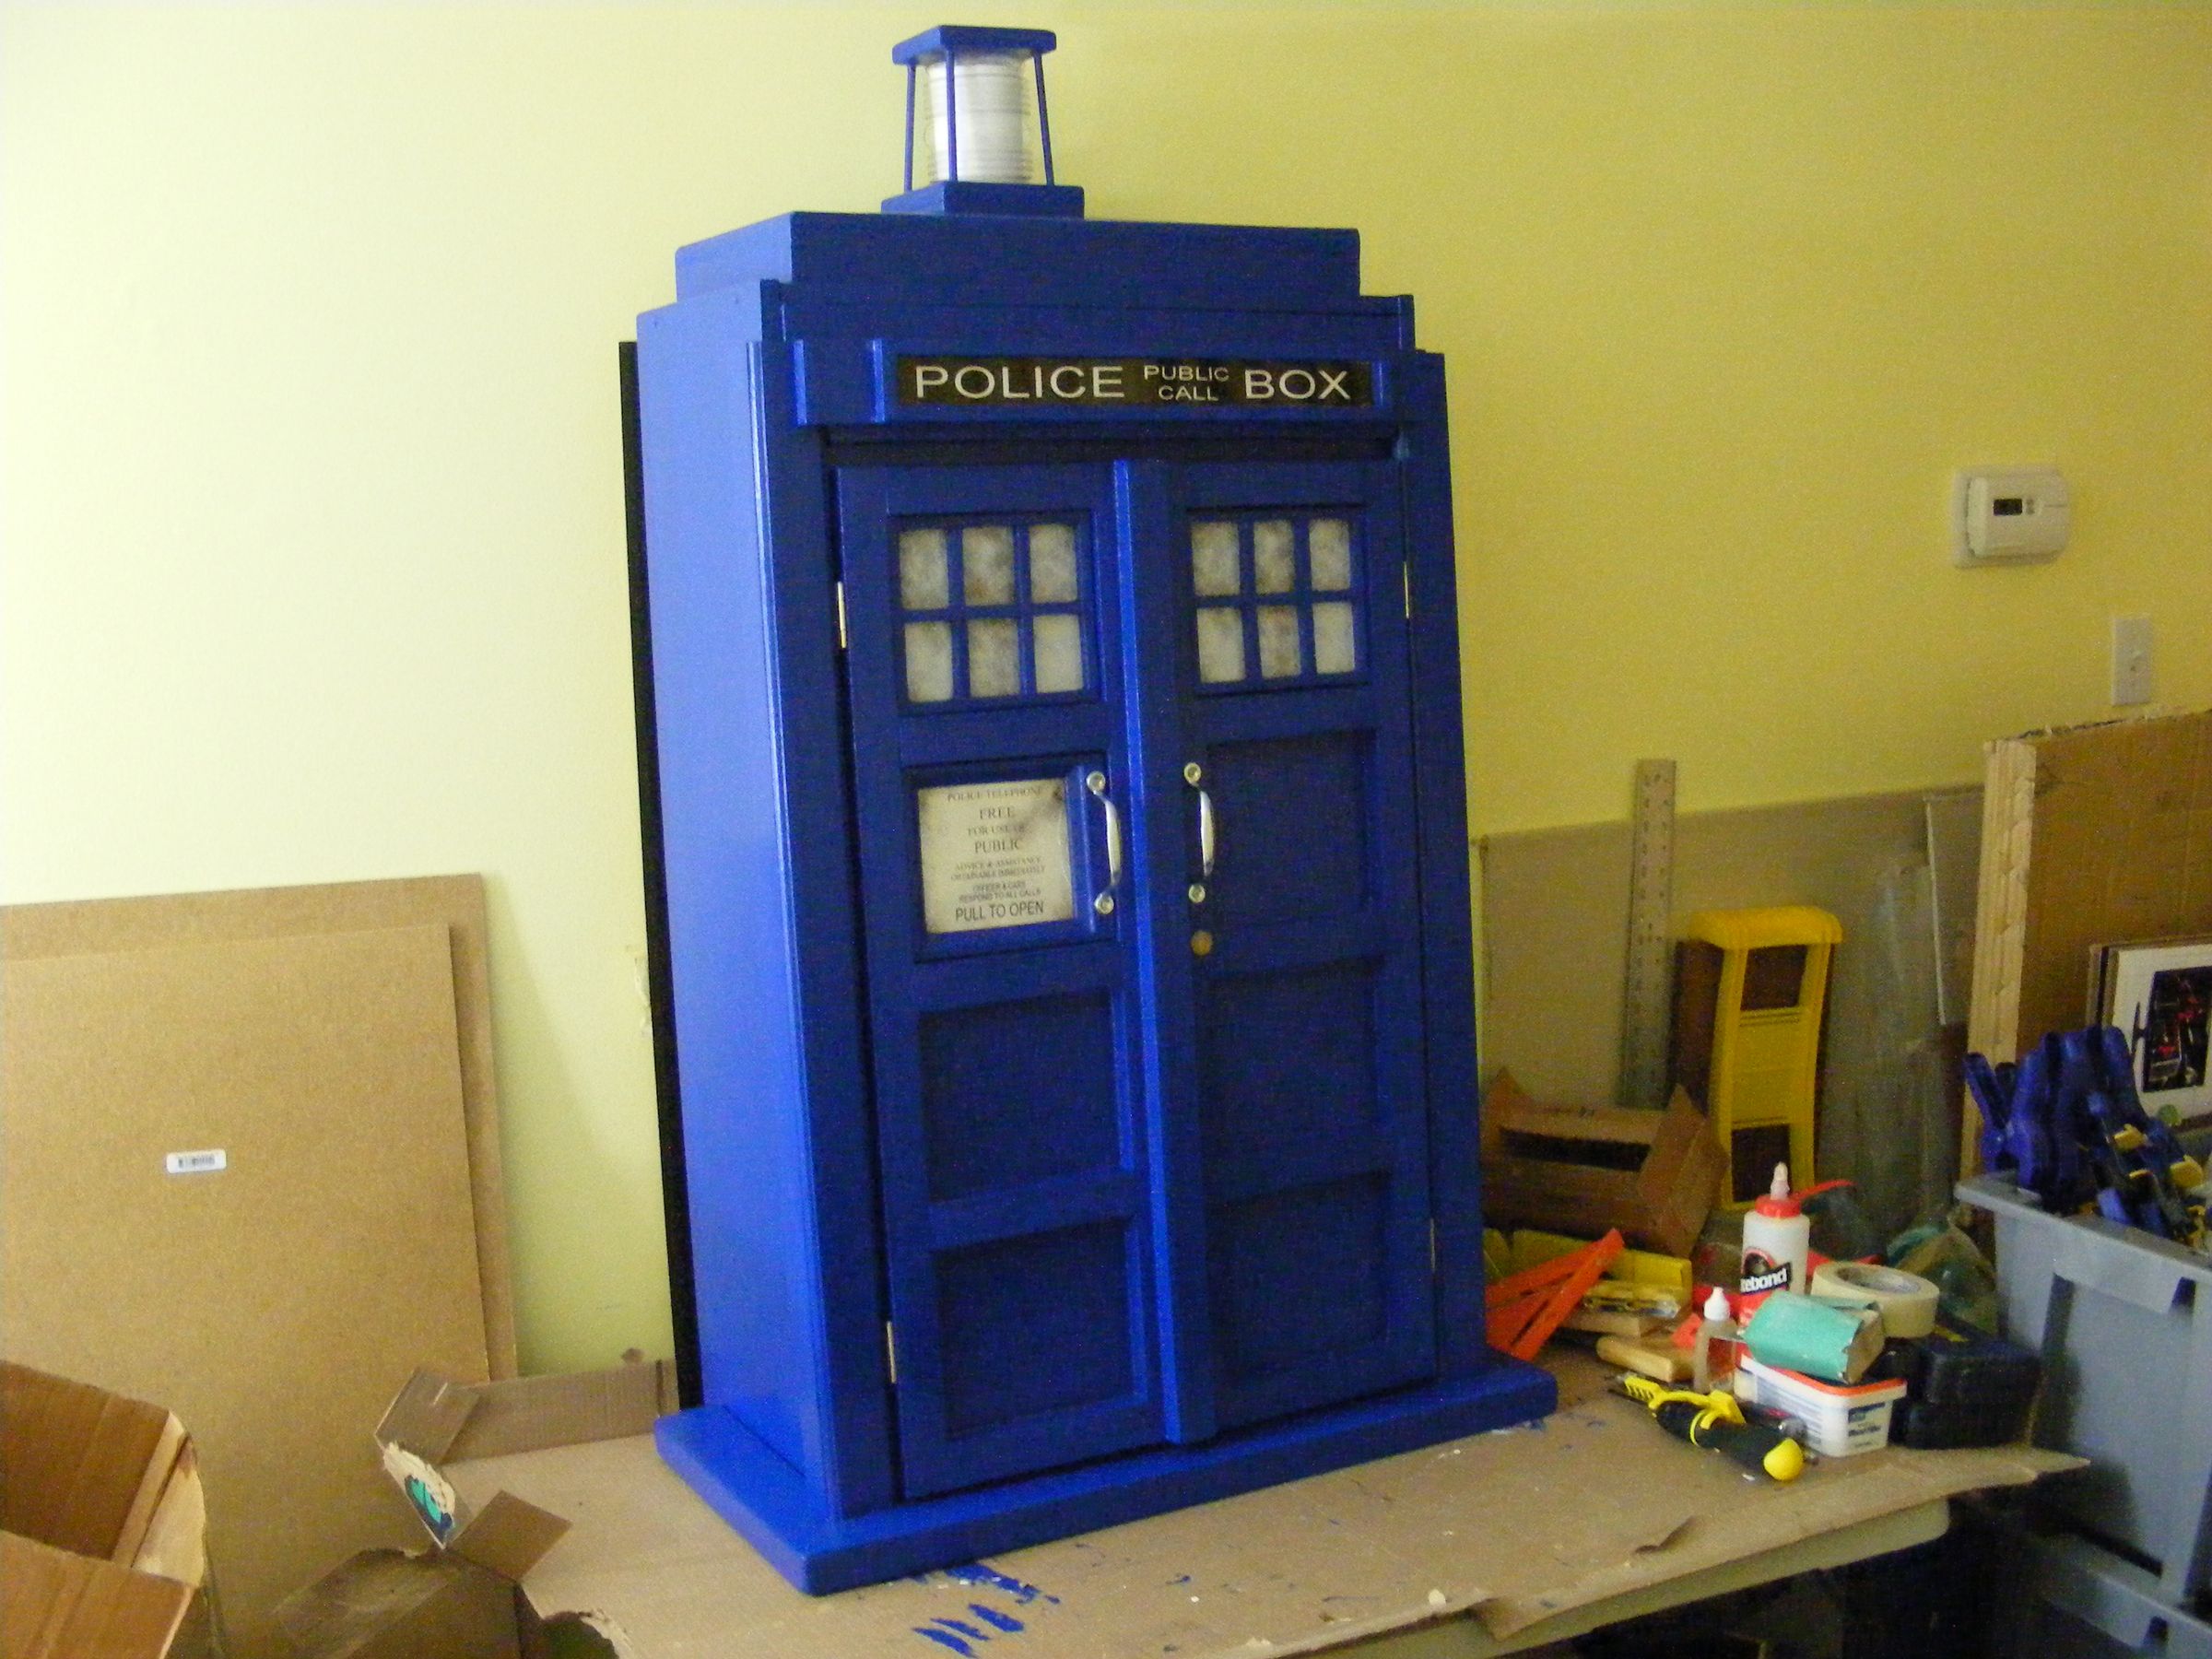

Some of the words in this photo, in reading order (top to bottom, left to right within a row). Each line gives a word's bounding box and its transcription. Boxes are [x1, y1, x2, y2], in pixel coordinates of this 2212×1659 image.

[915, 365, 1125, 399] POLICE
[1144, 365, 1230, 382] PUBLIC
[1158, 385, 1219, 401] CALL
[1244, 369, 1351, 400] BOX
[979, 806, 1015, 819] FREE
[974, 839, 1021, 853] PUBLIC
[956, 905, 986, 922] PULL
[989, 903, 1006, 918] TO
[1009, 900, 1044, 916] OPEN
